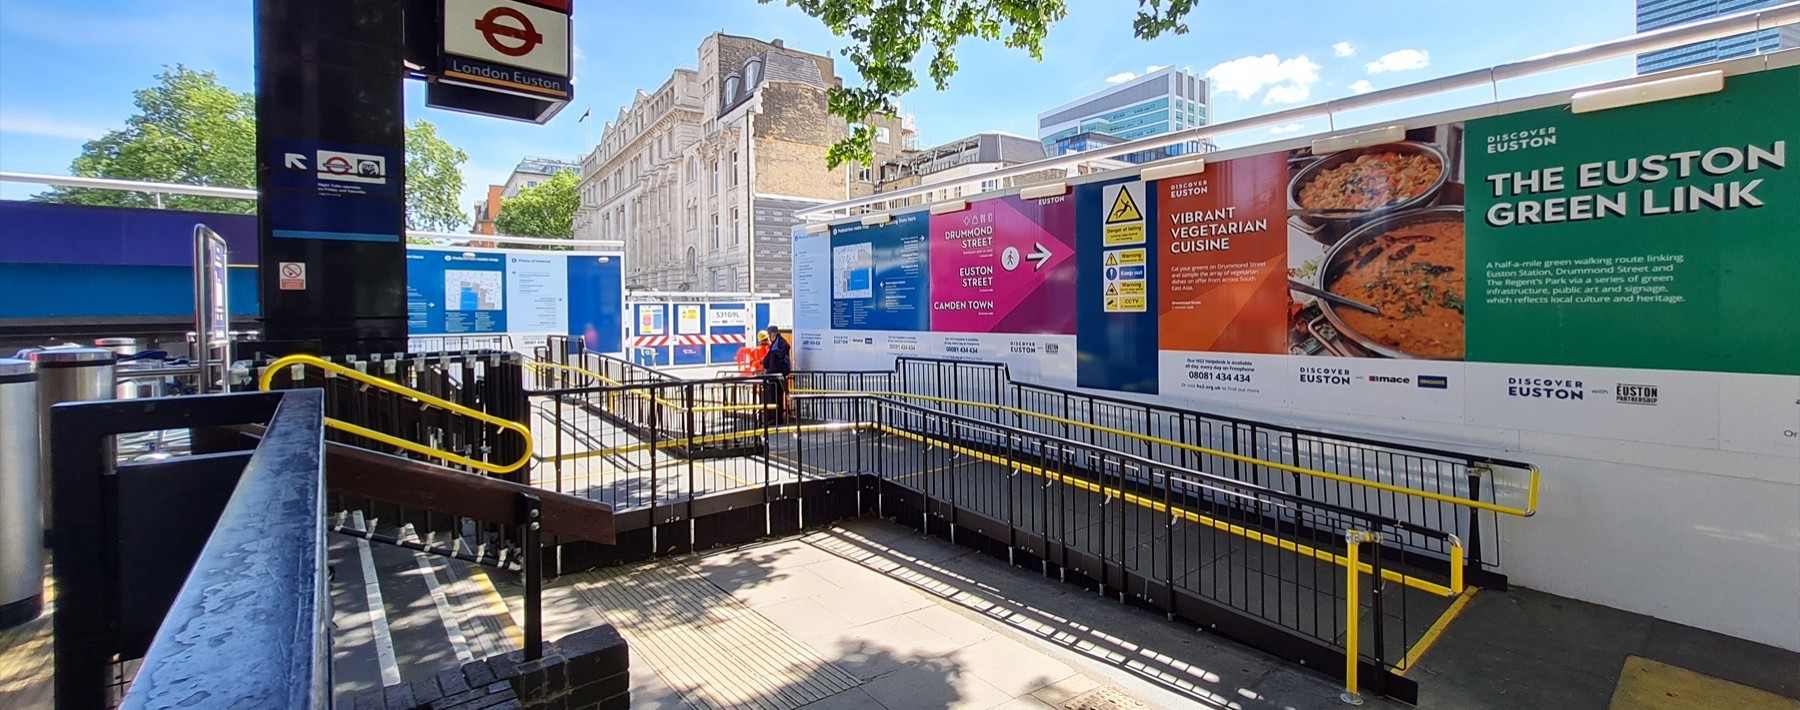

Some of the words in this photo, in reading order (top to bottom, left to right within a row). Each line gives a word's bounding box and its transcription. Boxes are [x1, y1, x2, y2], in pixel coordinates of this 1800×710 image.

[453, 60, 509, 80] London
[514, 71, 560, 90] Euston
[1487, 127, 1556, 143] DISCOVER
[1487, 136, 1556, 154] EUSTON
[1486, 166, 1565, 197] THE
[1578, 140, 1785, 188] EUSTON
[1171, 180, 1207, 190] DISCOVER
[1171, 186, 1208, 198] EUSTON
[1039, 196, 1064, 206] EUSTON
[1486, 192, 1626, 226] GREEN
[1641, 179, 1764, 216] LINK
[1170, 207, 1235, 225] VIBRANT
[945, 226, 992, 240] DRUMMOND
[1170, 219, 1267, 239] VEGETARIAN
[962, 238, 992, 249] STREET
[1170, 238, 1229, 253] CUISINE
[1495, 260, 1542, 268] half-a-mile
[1544, 259, 1571, 268] green
[1574, 257, 1612, 266] walking
[1647, 254, 1684, 264] linking
[960, 266, 993, 277] EUSTON
[1519, 269, 1553, 277] Station,
[1556, 267, 1614, 276] Drummond
[1652, 264, 1674, 272] and
[962, 277, 993, 287] STREET
[1594, 276, 1624, 284] series
[1641, 274, 1673, 284] green
[1486, 287, 1550, 296] infrastructure,
[1552, 286, 1582, 295] public
[1515, 296, 1548, 304] reflects
[1613, 294, 1634, 302] and
[1637, 294, 1685, 303] heritage.
[934, 301, 966, 310] CAMDEN
[968, 300, 993, 309] TOWN
[1189, 371, 1213, 380] 08081
[1216, 373, 1232, 381] 434
[1234, 374, 1250, 382] 434
[1300, 367, 1350, 375] DISCOVER
[1300, 374, 1350, 385] EUSTON
[1509, 377, 1583, 388] DISCOVER
[1509, 386, 1584, 400] EUSTON
[1616, 385, 1658, 397] EUSTON
